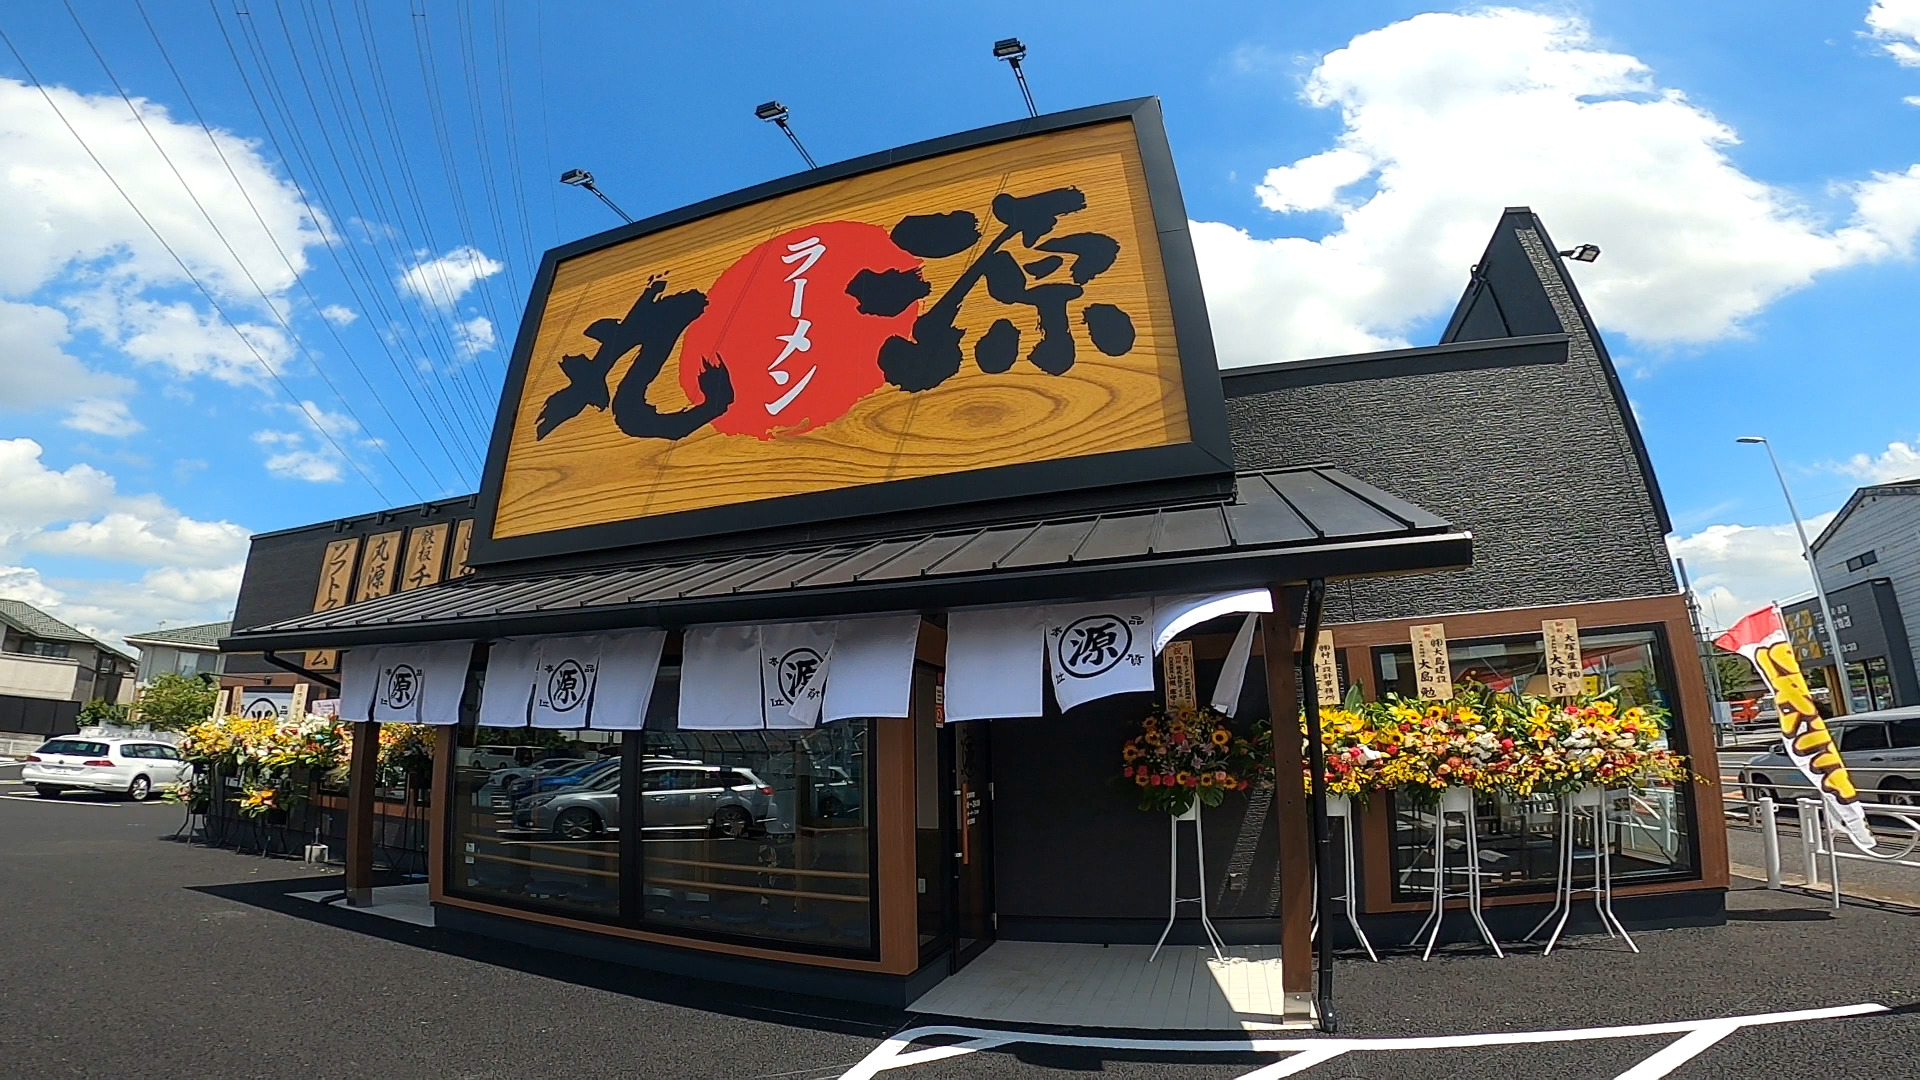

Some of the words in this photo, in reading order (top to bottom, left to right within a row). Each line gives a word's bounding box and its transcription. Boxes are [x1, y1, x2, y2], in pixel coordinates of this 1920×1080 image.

[764, 237, 826, 415] ラーメン
[365, 536, 389, 600] 丸源
[1068, 622, 1118, 667] 源
[391, 673, 412, 702] 源
[554, 669, 578, 704] 源
[1419, 659, 1433, 682] 大島
[1552, 682, 1566, 693] 守
